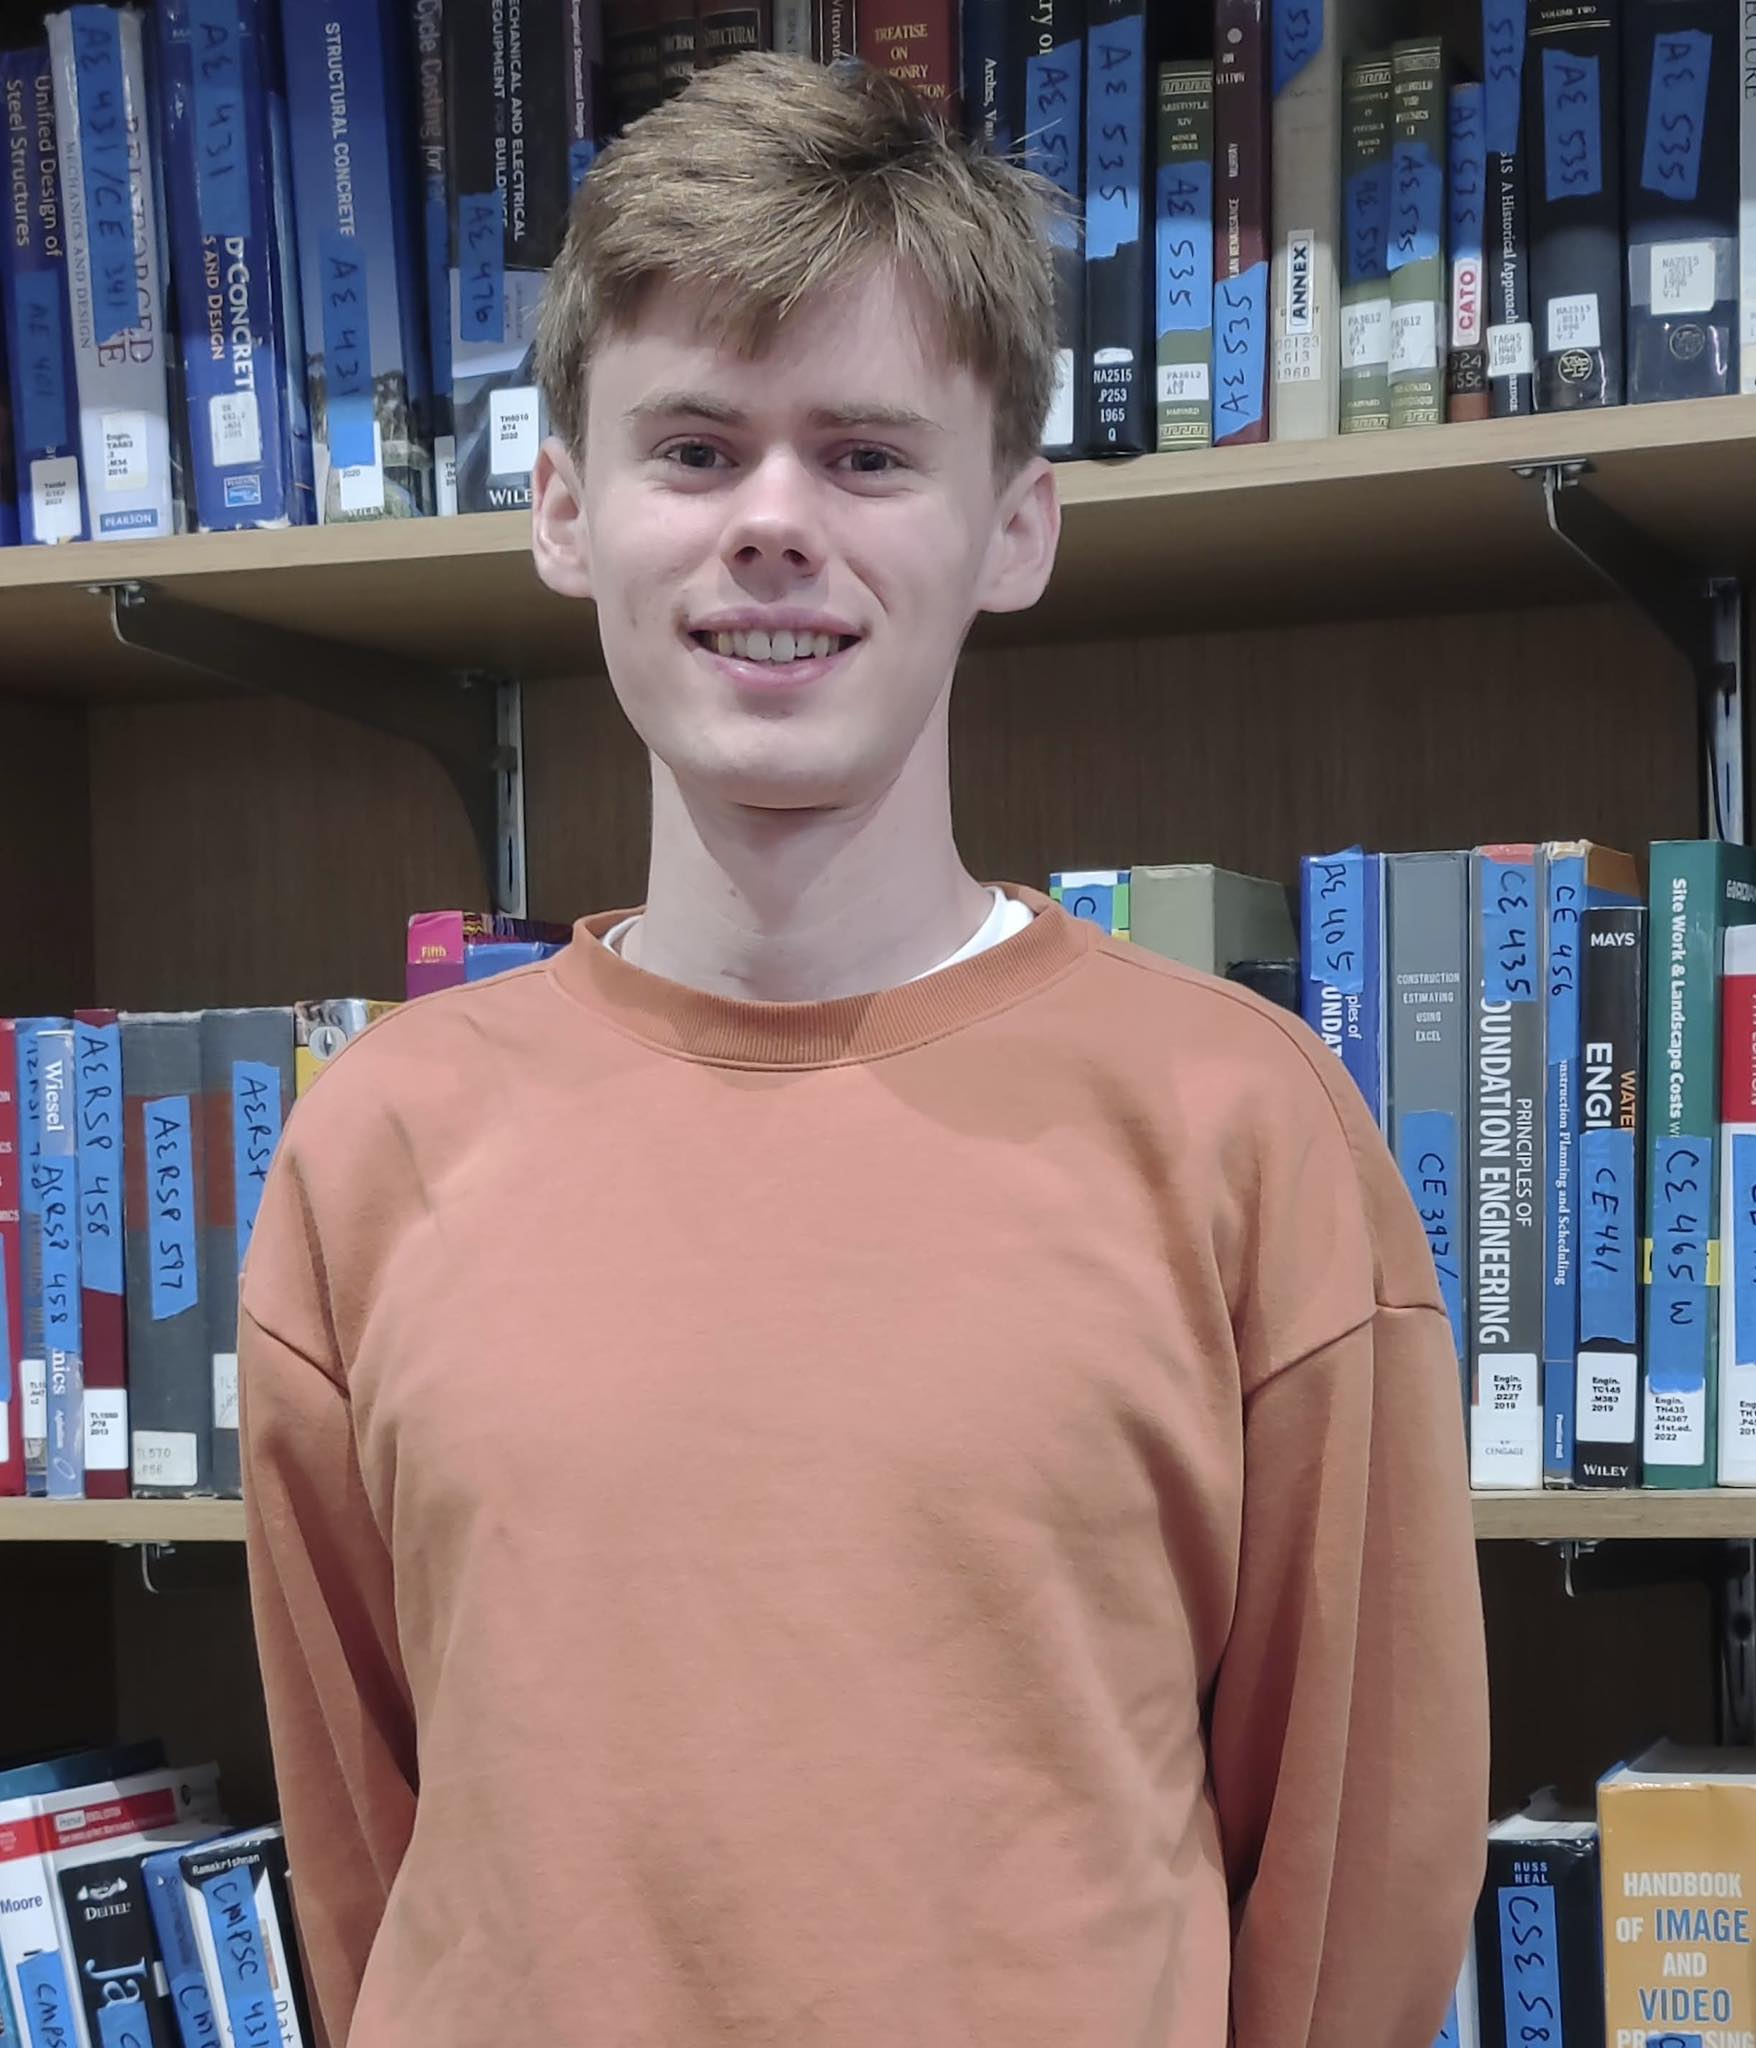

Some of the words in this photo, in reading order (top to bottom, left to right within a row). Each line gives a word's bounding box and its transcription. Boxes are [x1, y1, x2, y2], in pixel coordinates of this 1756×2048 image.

[874, 24, 929, 43] TREATISE
[1541, 9, 1574, 20] VOLUME
[1576, 5, 1597, 16] TWO
[491, 0, 506, 98] EQUIPMENT
[890, 46, 909, 61] ON
[1097, 45, 1132, 96] AE
[1659, 42, 1695, 88] AE
[325, 21, 348, 140] STRUCTURAL
[420, 59, 444, 138] Costing
[984, 57, 998, 107] Arches,
[1036, 66, 1070, 114] AE
[1552, 64, 1587, 110] AE
[6, 80, 27, 131] Steel
[35, 75, 55, 142] Unified
[511, 97, 524, 135] AND
[1040, 133, 1070, 192] 53
[1098, 122, 1128, 209] 535
[1559, 129, 1590, 185] 535
[1658, 113, 1694, 181] 535
[10, 136, 30, 246] Structures
[39, 159, 58, 229] Design
[333, 142, 356, 237] CONCRETE
[511, 138, 526, 242] ELECTRICAL
[1167, 179, 1199, 217] AE
[1500, 182, 1514, 193] A
[44, 238, 63, 257] of
[1500, 193, 1517, 260] Historical
[73, 249, 88, 283] AND
[204, 251, 220, 289] AND
[1168, 238, 1196, 307] 535
[1292, 246, 1308, 321] ANNEX
[76, 286, 91, 349] DESIGN
[1459, 270, 1475, 330] CATO
[1500, 264, 1518, 324] Approach
[208, 294, 226, 361] DESIGN
[228, 262, 256, 391] CONCRET
[1222, 284, 1253, 355] 535
[1093, 368, 1133, 384] NA2515
[1098, 388, 1128, 403] .P253
[1220, 368, 1249, 416] AE
[1100, 408, 1126, 423] 1965
[1107, 428, 1117, 442] Q
[104, 514, 152, 527] PEARSON
[488, 488, 534, 506] WILE
[1316, 863, 1348, 900] AE
[1496, 869, 1529, 915] CE
[1553, 885, 1578, 925] CE
[1671, 877, 1687, 913] Site
[421, 945, 447, 959] Fifth
[1320, 908, 1355, 972] 405
[1498, 929, 1531, 996] 435
[1590, 932, 1636, 947] MAYS
[1670, 915, 1687, 962] Work
[1396, 972, 1460, 985] CONSTRUCTION
[1551, 944, 1573, 996] 456
[1671, 964, 1686, 977] &
[1402, 992, 1454, 1005] ESTIMATING
[1416, 1011, 1441, 1023] USING
[1348, 1026, 1364, 1040] of
[1415, 1030, 1441, 1042] EXCEL
[1667, 981, 1687, 1070] Landscape
[44, 1060, 65, 1132] Wiesel
[81, 1035, 113, 1151] AERSP
[1479, 998, 1512, 1158] OUNDATION
[1585, 1042, 1613, 1128] ENGI
[1619, 1070, 1637, 1128] WATE
[1668, 1074, 1685, 1119] Costs
[153, 1116, 182, 1221] AERSP
[1515, 1097, 1533, 1199] PRINCIPLES
[1554, 1131, 1572, 1189] Planning
[1418, 1152, 1448, 1196] CE
[1591, 1167, 1620, 1216] CE
[1664, 1149, 1700, 1203] CE
[84, 1175, 111, 1236] 458
[1515, 1202, 1533, 1228] OF
[1558, 1189, 1571, 1214] and
[159, 1240, 185, 1290] 597
[1478, 1166, 1512, 1345] ENGINEERING
[1553, 1215, 1571, 1286] Scheduling
[1667, 1214, 1699, 1282] 465
[46, 1273, 68, 1324] 458
[1493, 1374, 1522, 1385] Engin.
[1493, 1384, 1523, 1392] TA775
[1591, 1376, 1621, 1386] Engin.
[1654, 1396, 1683, 1405] Engin.
[1591, 1404, 1614, 1413] 2019
[1484, 1447, 1524, 1456] CENGAGE
[1654, 1433, 1677, 1441] 2022
[1583, 1464, 1629, 1477] WILEY
[192, 1854, 261, 1876] Ramakrishnan
[1513, 1861, 1549, 1873] RUSS
[1623, 1871, 1743, 1898] HANDBOOK
[0, 1895, 43, 1914] Moore
[1615, 1917, 1644, 1943] OF
[1655, 1908, 1750, 1943] IMAGE
[212, 1881, 259, 1982] CMPSC
[1508, 1895, 1545, 1974] CSE
[84, 1956, 148, 2008] Ja
[1662, 1951, 1708, 1978] AND
[1518, 1990, 1555, 2048] 58
[1639, 1988, 1732, 2023] VIDEO
